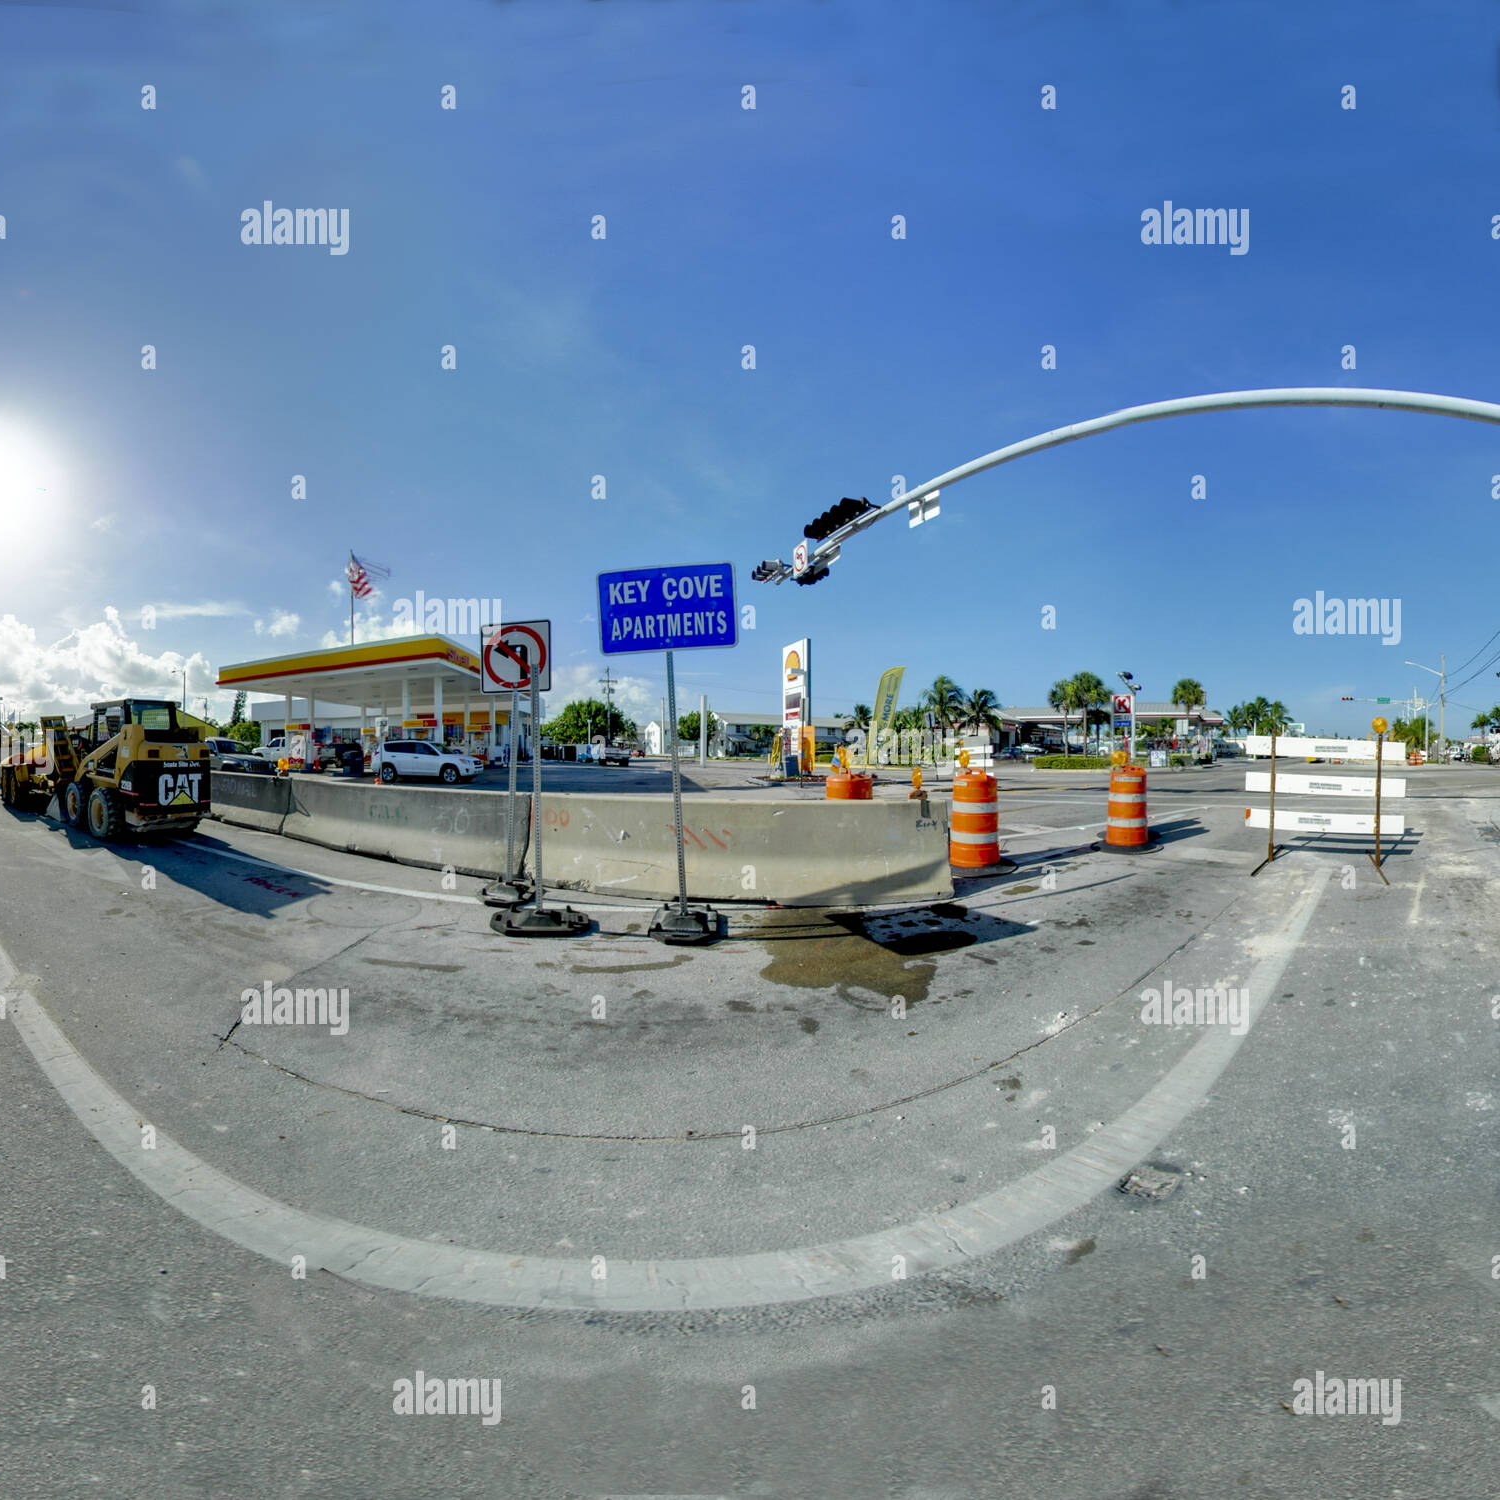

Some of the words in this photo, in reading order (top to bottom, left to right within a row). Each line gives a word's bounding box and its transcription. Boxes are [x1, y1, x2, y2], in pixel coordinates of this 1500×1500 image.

[609, 579, 650, 605] KEY
[662, 575, 724, 600] COVE
[611, 610, 727, 641] APARTMENTS
[882, 693, 894, 720] MORE
[158, 773, 202, 806] CAT
